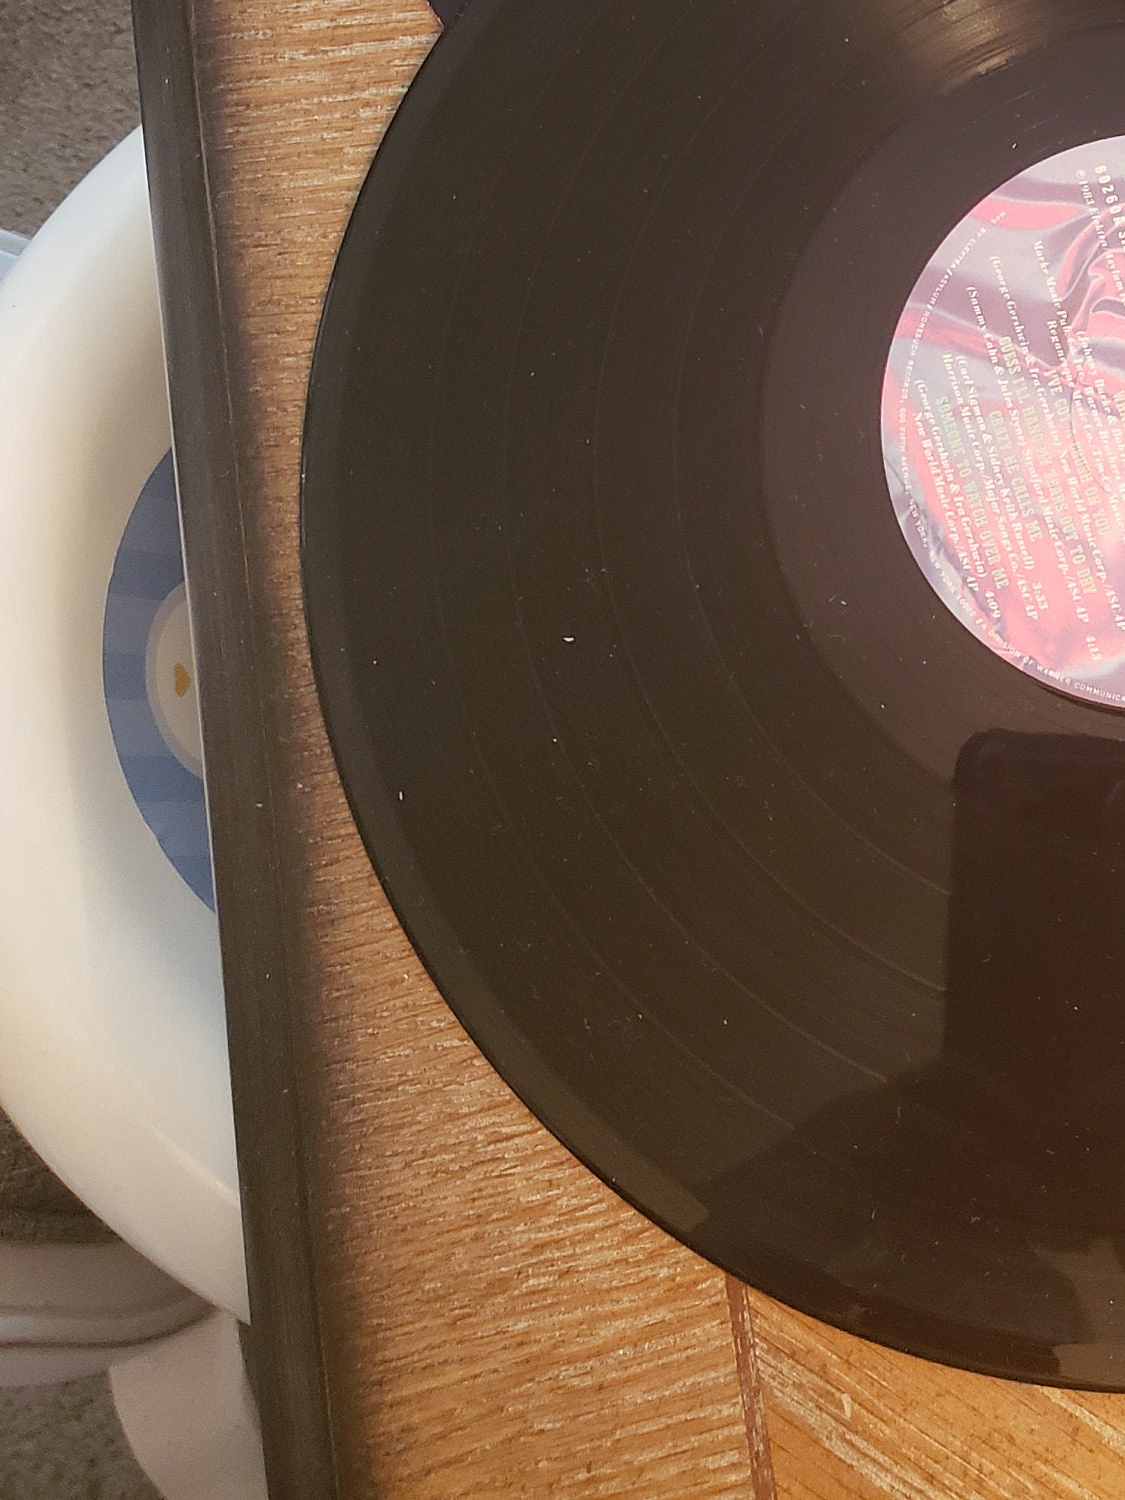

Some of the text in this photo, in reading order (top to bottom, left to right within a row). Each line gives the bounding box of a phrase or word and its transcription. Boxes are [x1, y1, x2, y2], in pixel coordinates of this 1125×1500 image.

[1043, 274, 1064, 310] Music
[997, 335, 1022, 375] GUESS
[940, 351, 968, 405] Harrison
[958, 403, 979, 440] Music
[1004, 298, 1032, 354] Gershwin
[1023, 352, 1037, 367] &
[1065, 474, 1088, 514] World
[1078, 512, 1100, 549] Music
[1021, 404, 1045, 443] HANG
[1105, 412, 1118, 426] &
[929, 424, 957, 483] Gershwin
[947, 481, 961, 496] &
[992, 363, 1006, 377] &
[1040, 504, 1061, 542] Music
[1034, 444, 1053, 467] MY
[919, 436, 943, 480] World
[933, 477, 953, 512] Music
[934, 394, 1010, 590] SOMEONE TO WATCH OVER ME
[980, 431, 993, 444] &
[999, 485, 1020, 522] Keith
[987, 408, 1044, 543] CRAZY HE CALLS ME
[1042, 469, 1068, 512] TEARS
[1083, 484, 1102, 506] ON
[1058, 514, 1079, 544] OUT
[1090, 507, 1113, 538] YOU
[1067, 543, 1087, 566] TO
[1075, 566, 1097, 597] DRY
